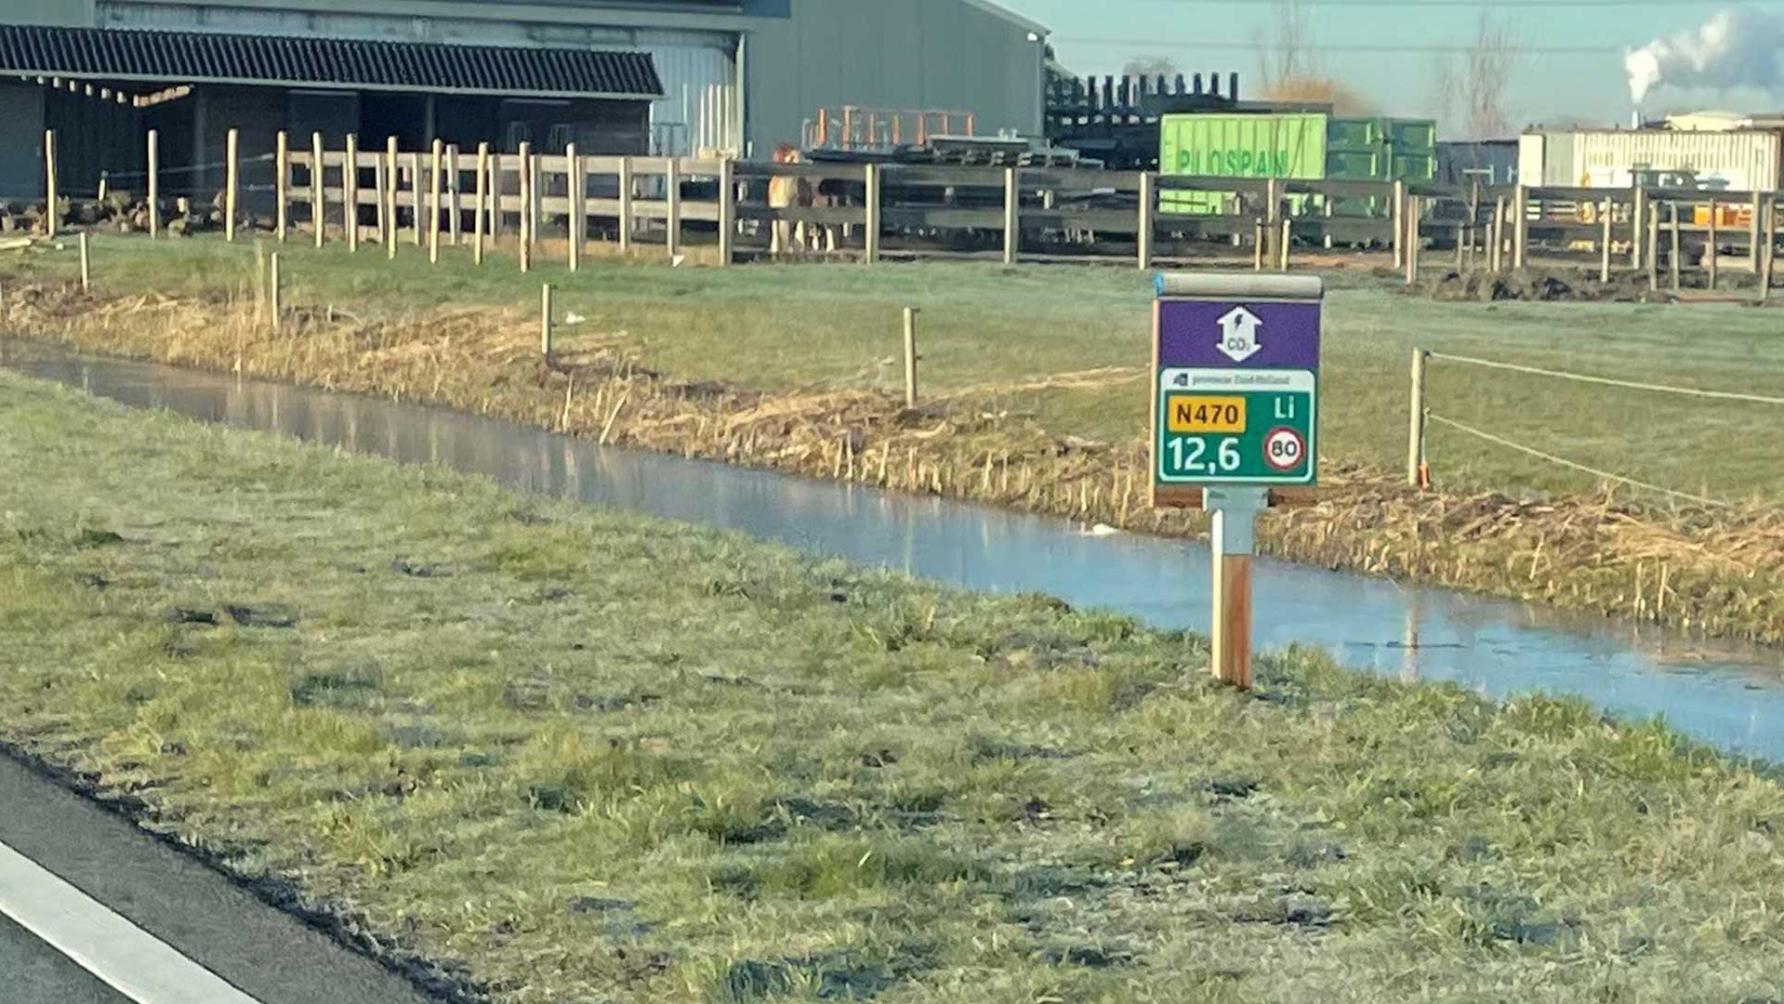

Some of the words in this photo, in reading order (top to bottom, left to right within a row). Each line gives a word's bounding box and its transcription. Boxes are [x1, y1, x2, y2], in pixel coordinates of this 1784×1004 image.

[1176, 404, 1239, 425] N470
[1274, 396, 1295, 419] Li
[1167, 436, 1241, 475] 12,6
[1271, 440, 1298, 457] 80
